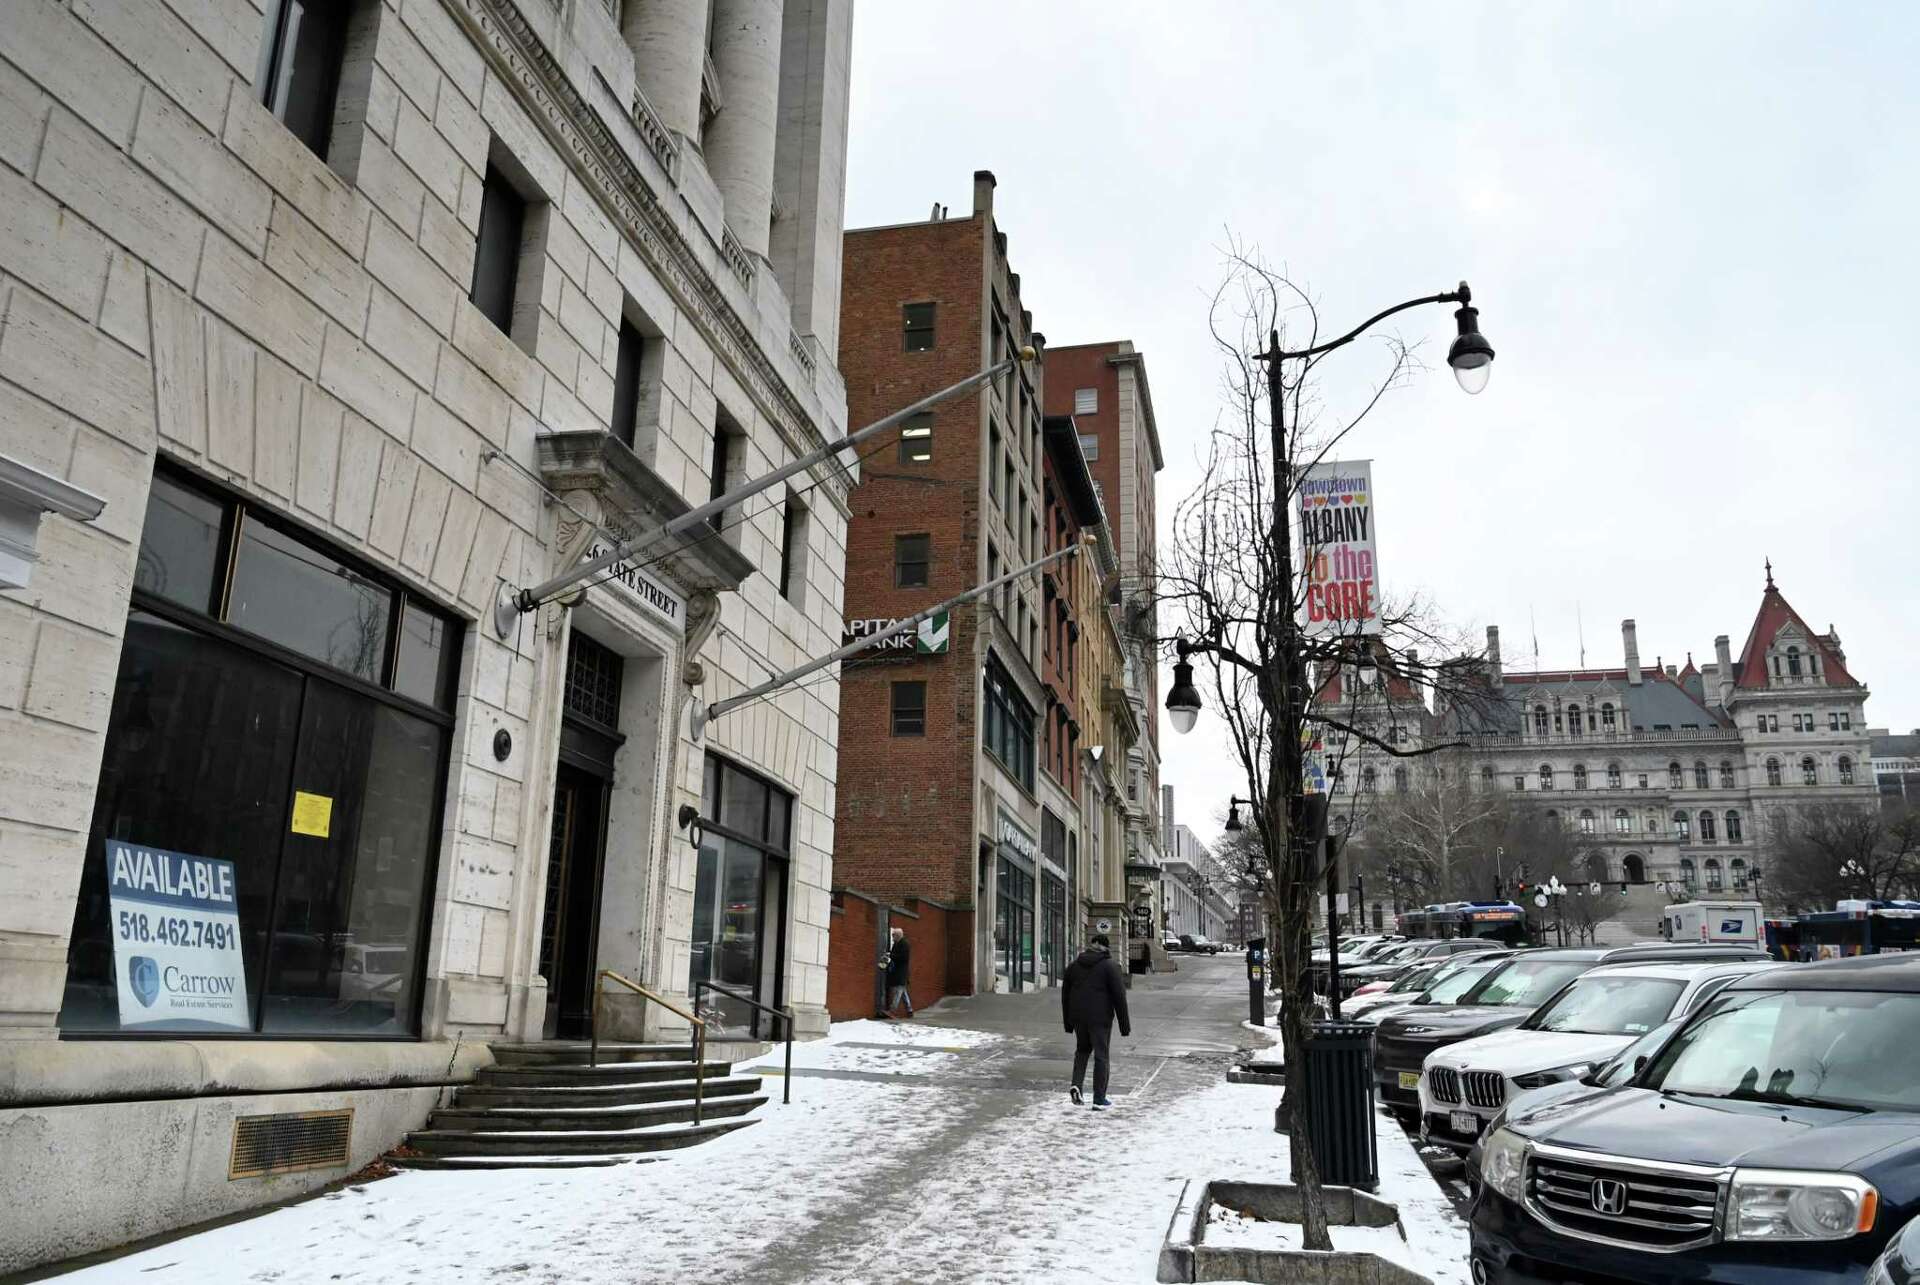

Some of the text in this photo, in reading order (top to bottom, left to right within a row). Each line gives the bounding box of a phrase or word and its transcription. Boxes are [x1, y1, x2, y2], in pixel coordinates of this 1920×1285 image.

[1303, 506, 1368, 546] ALBANY
[1333, 544, 1373, 581] the
[637, 576, 678, 618] STREET
[1308, 580, 1376, 622] CORE
[112, 847, 233, 902] AVAILABLE
[120, 910, 236, 951] 518.462.7491
[163, 965, 236, 994] Carrow
